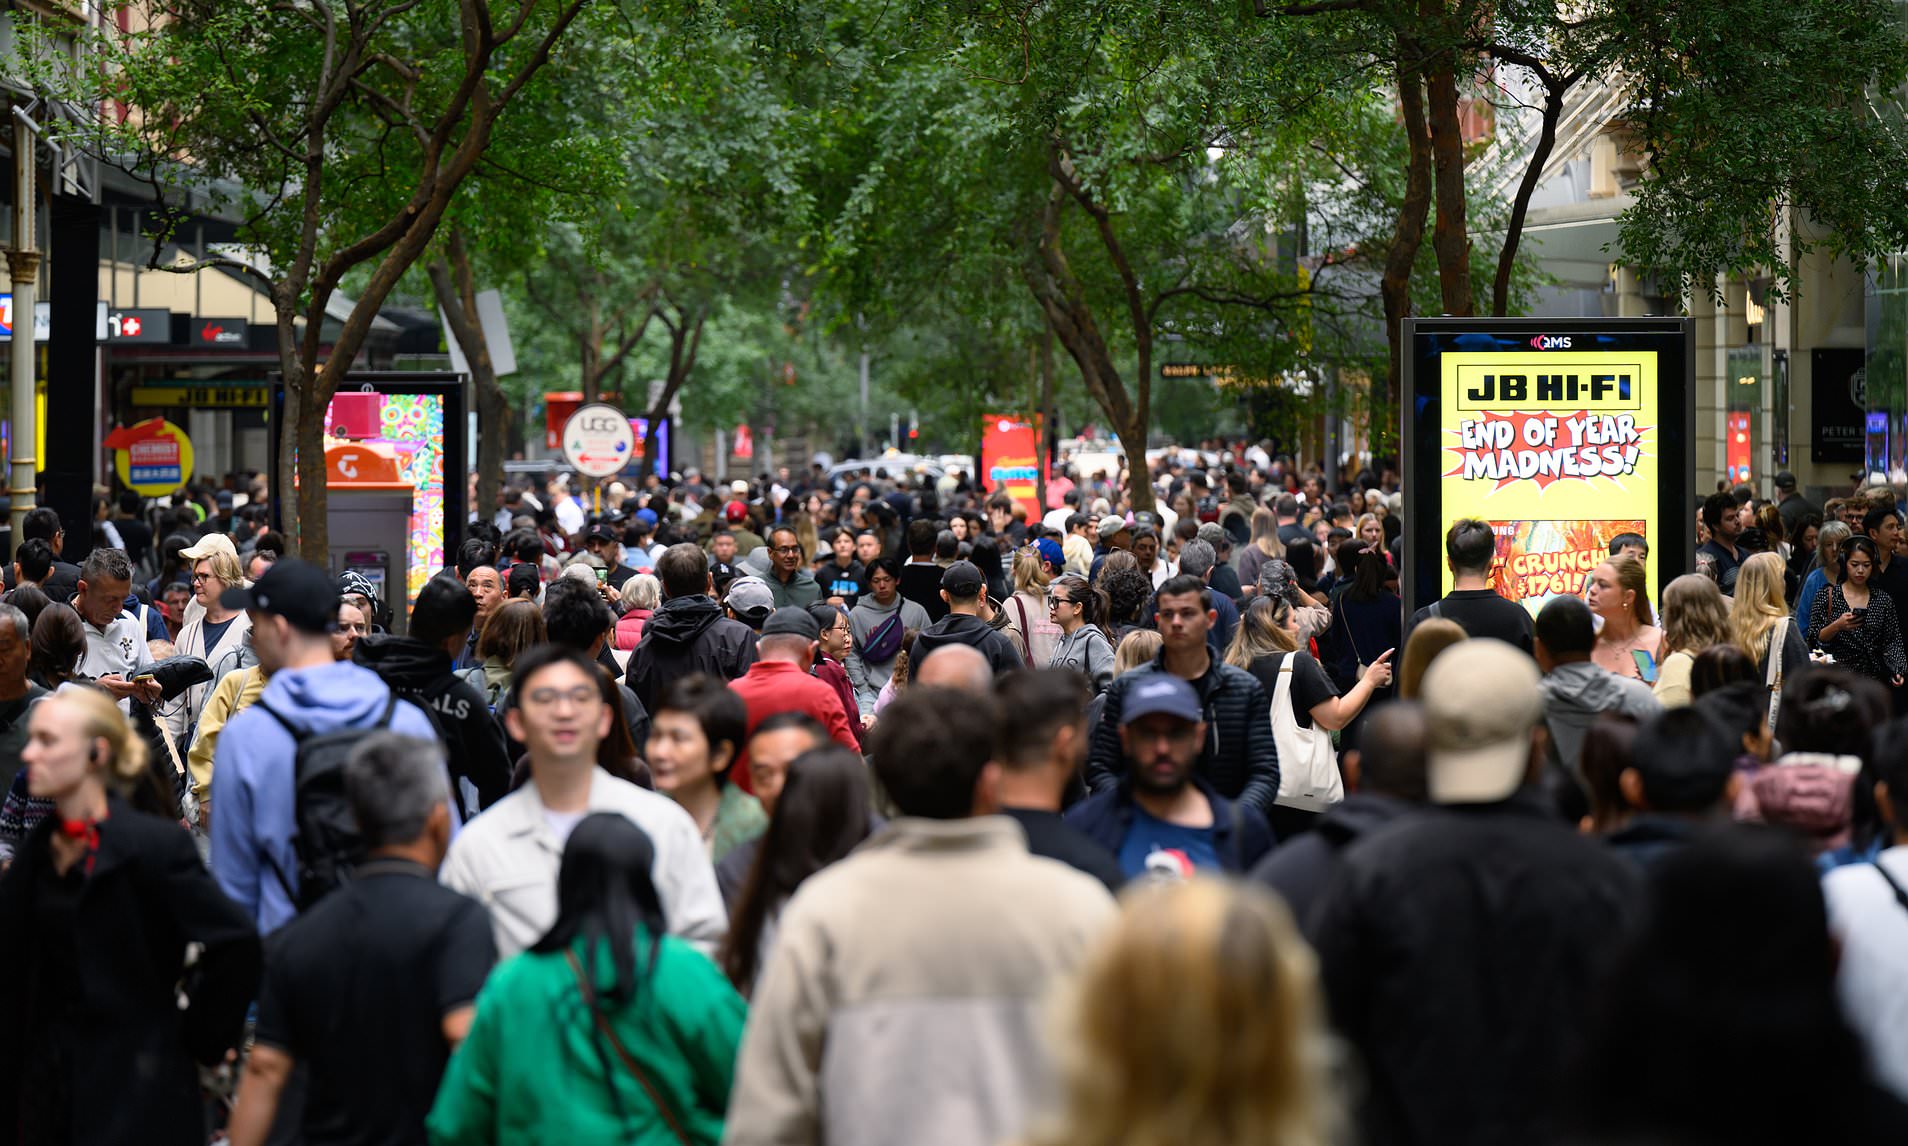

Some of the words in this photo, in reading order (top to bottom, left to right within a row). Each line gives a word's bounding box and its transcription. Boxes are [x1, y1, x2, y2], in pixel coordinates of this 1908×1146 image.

[1540, 336, 1572, 349] QMS
[1467, 375, 1527, 401] JB
[1537, 375, 1631, 401] HI-FI
[580, 416, 619, 432] UGG
[1461, 419, 1516, 450] END
[1523, 417, 1559, 448] OF
[1565, 414, 1640, 447] YEAR
[1822, 425, 1856, 437] PETER
[1463, 445, 1640, 480] MADNESS!
